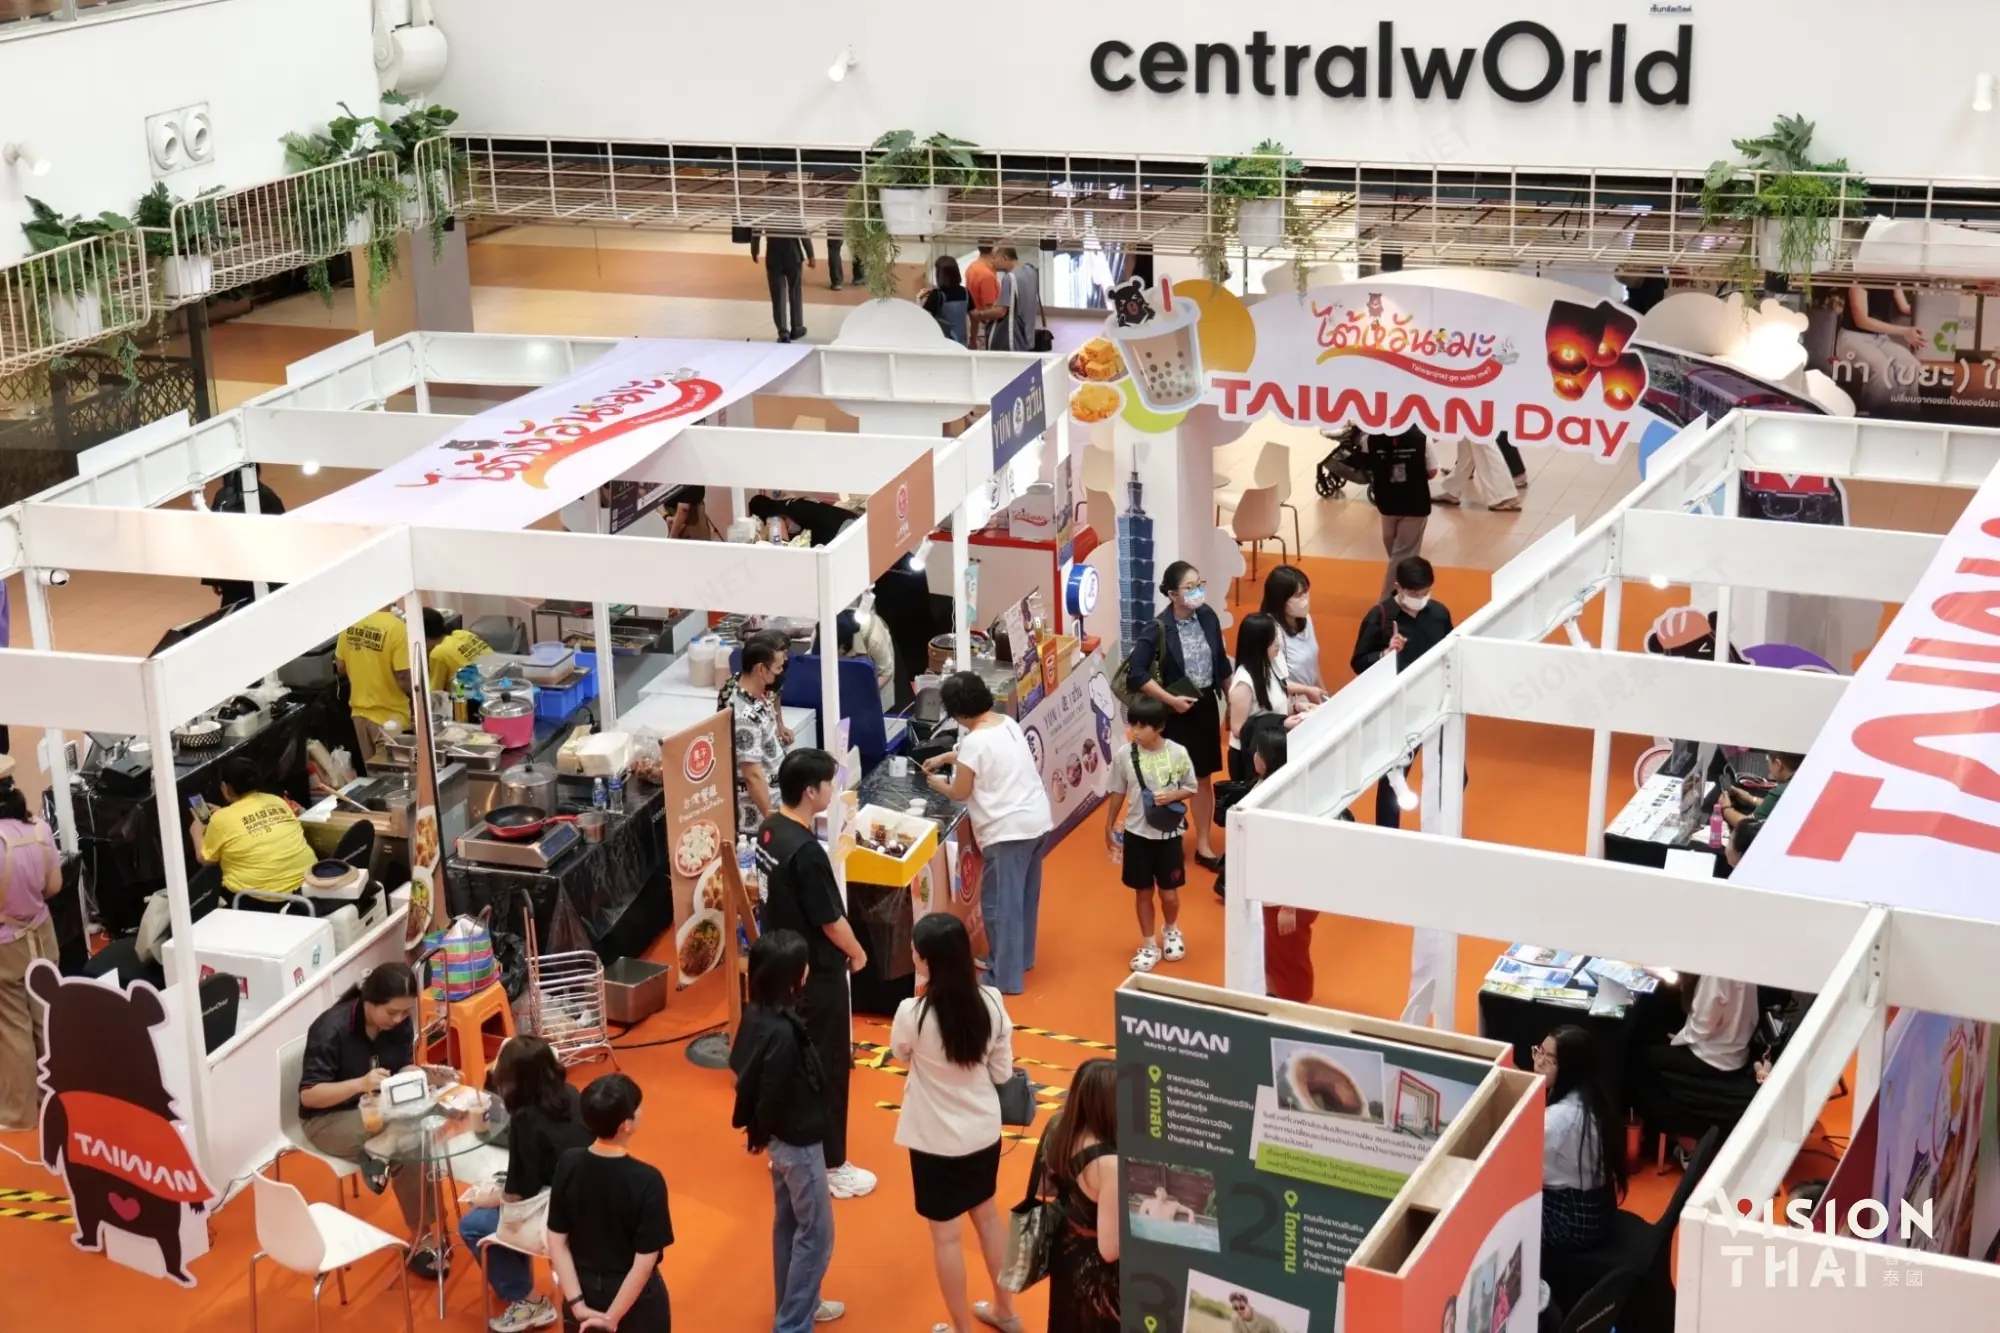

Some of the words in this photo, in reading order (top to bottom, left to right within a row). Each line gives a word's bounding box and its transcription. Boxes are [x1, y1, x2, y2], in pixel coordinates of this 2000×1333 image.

[1832, 351, 1870, 383] ทำ
[1883, 356, 1971, 394] (ขยะ)
[1211, 378, 1494, 437] TAIWAN
[1515, 403, 1630, 458] Day
[1121, 1015, 1229, 1054] TAIWAN
[73, 1131, 196, 1192] TAIWAN
